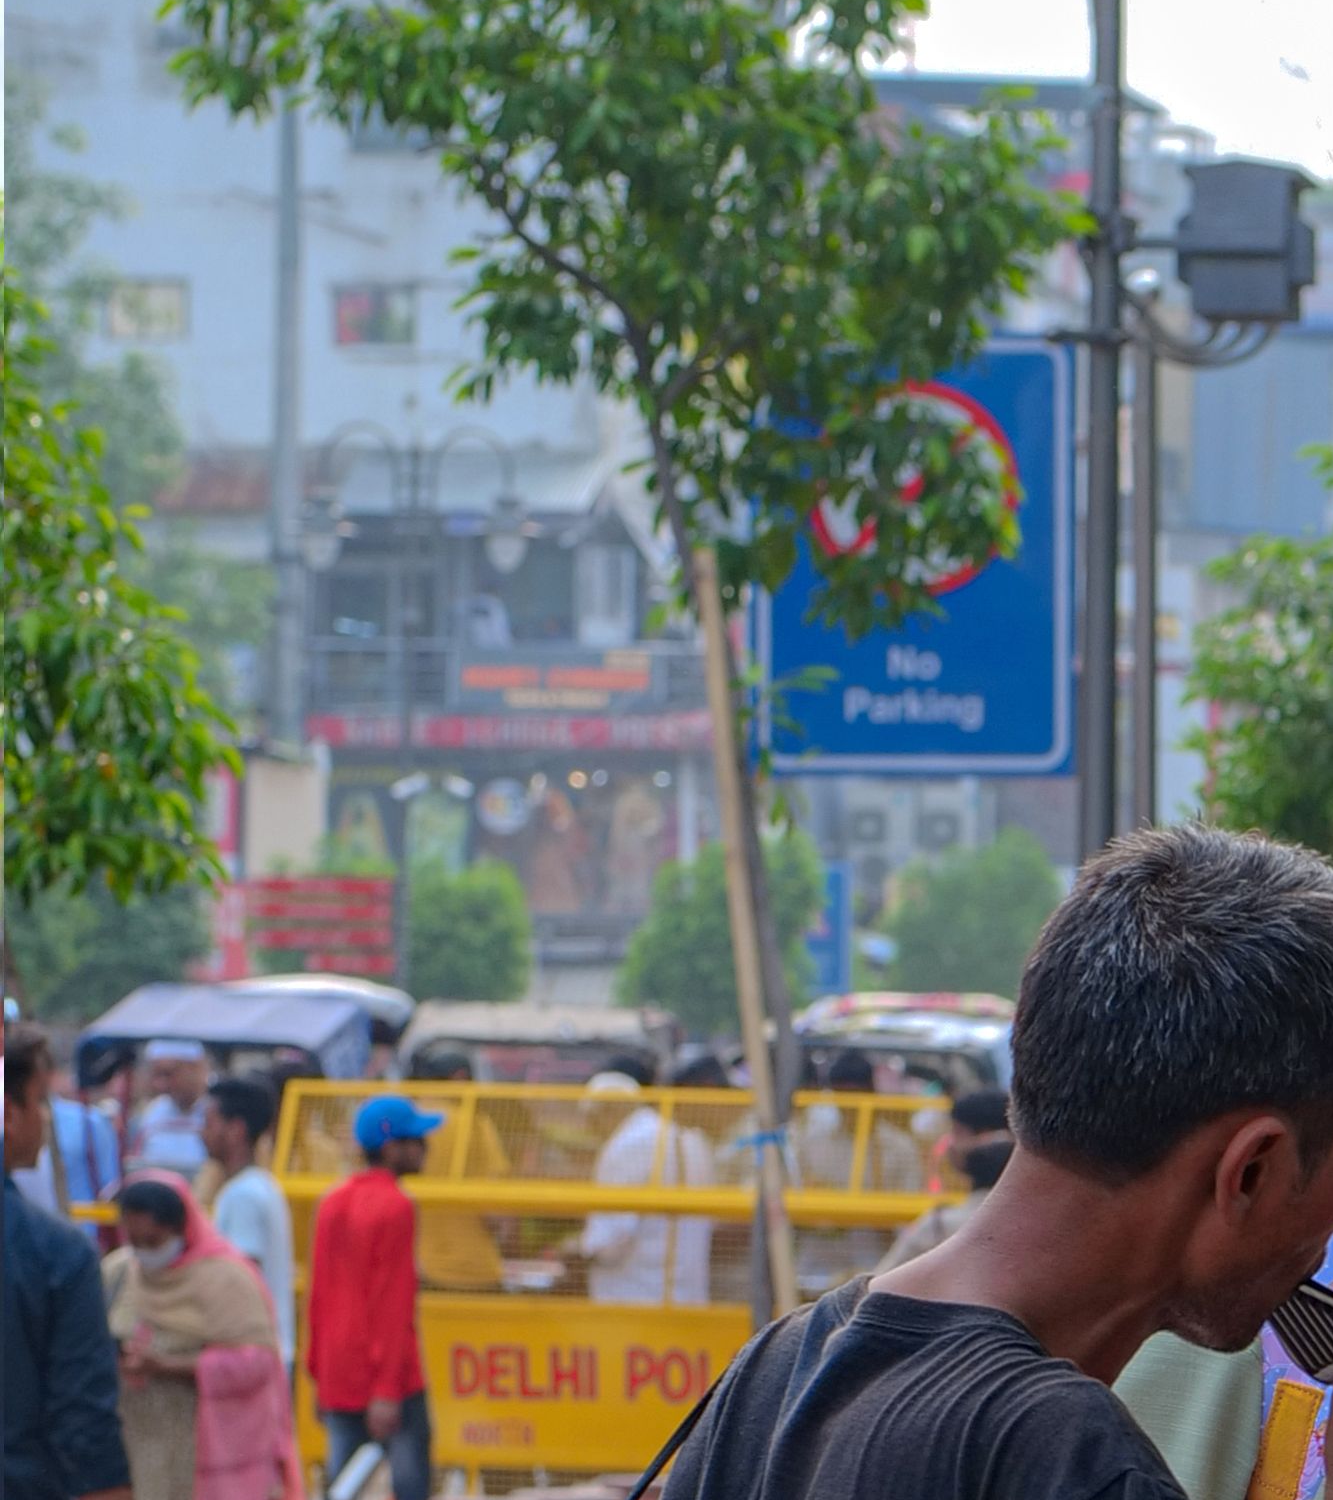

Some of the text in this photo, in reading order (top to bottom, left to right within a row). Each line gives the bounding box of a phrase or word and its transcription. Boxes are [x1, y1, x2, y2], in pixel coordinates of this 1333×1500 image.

[886, 644, 941, 681] No
[843, 686, 985, 733] Parking
[450, 1345, 597, 1399] DELHI
